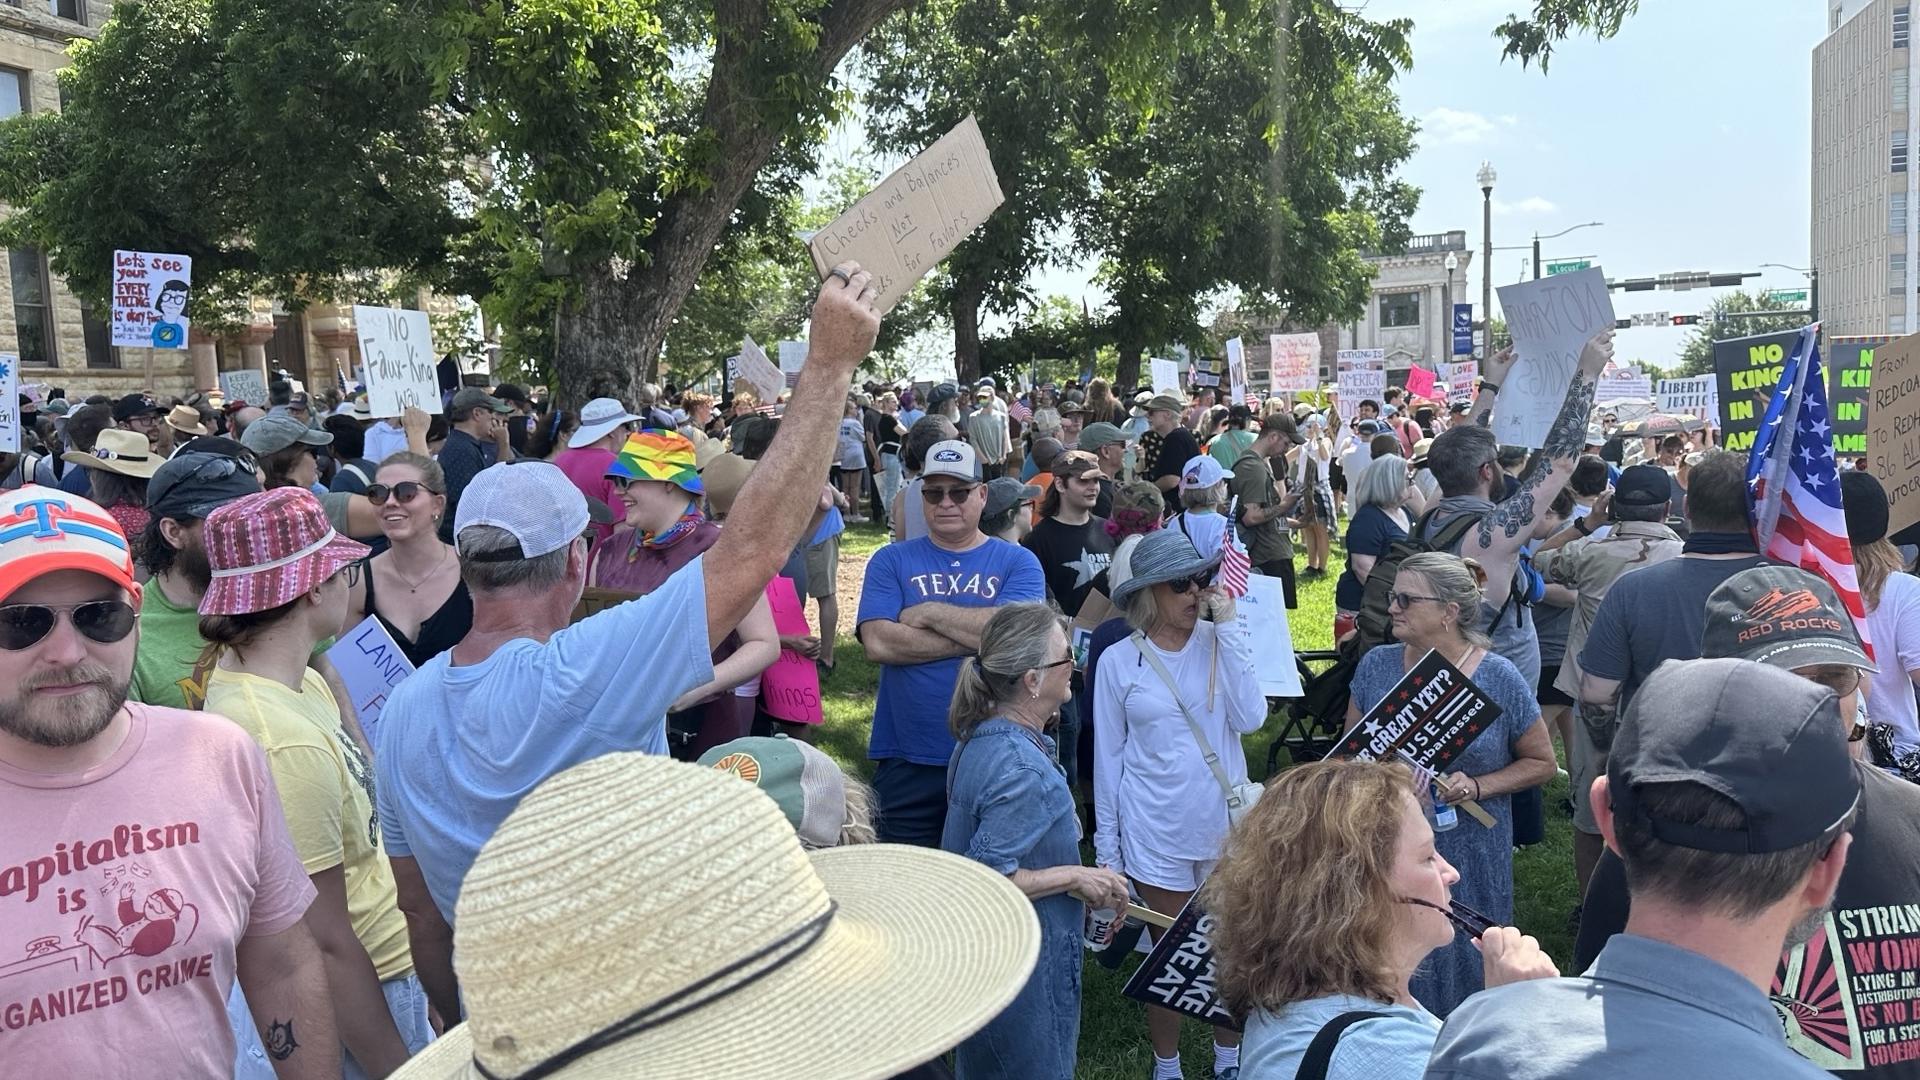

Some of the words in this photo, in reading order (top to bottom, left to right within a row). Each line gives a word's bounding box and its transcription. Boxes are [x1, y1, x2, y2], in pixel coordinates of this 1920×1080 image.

[824, 208, 877, 256] Checks
[885, 188, 904, 210] and
[905, 153, 960, 193] Balances
[891, 214, 913, 239] Not
[904, 252, 921, 272] for
[929, 210, 969, 252] Favors
[116, 268, 148, 282] your
[151, 257, 183, 272] see
[114, 309, 124, 322] is
[386, 312, 409, 341] NO
[1338, 350, 1372, 359] NOTHING
[1374, 350, 1383, 359] IS
[1749, 343, 1784, 366] NO
[1859, 349, 1875, 368] N
[1878, 352, 1910, 380] FROM
[363, 338, 436, 398] Faux-King
[1338, 373, 1384, 387] AMERICAN
[1452, 364, 1473, 375] LOVE
[1731, 365, 1786, 392] KING
[1841, 369, 1872, 388] KI
[1660, 380, 1709, 395] LIBERTY
[1666, 394, 1709, 409] JUSTIC
[1729, 400, 1754, 421] IN
[1837, 402, 1861, 421] IN
[1725, 430, 1757, 451] AM
[1873, 428, 1889, 448] TO
[935, 450, 960, 462] Ford
[1876, 450, 1897, 481] 86
[1903, 434, 1920, 466] AL
[1888, 475, 1920, 507] UTOCR
[15, 498, 70, 541] T
[1088, 552, 1112, 564] ONE
[910, 573, 1000, 600] TEXAS
[1737, 623, 1773, 643] RED
[1780, 617, 1842, 632] ROCKS
[1369, 704, 1418, 755] GREAT
[1411, 669, 1453, 712] YET?
[56, 887, 88, 915] is
[1089, 919, 1110, 946] hint
[1147, 913, 1217, 1004] GREAT
[0, 976, 129, 1032] GANIZED
[136, 953, 214, 996] CRIME
[1852, 970, 1896, 993] LYING
[1901, 970, 1916, 988] IN
[1858, 1004, 1878, 1028] IS
[1882, 1001, 1908, 1025] NO
[1863, 1028, 1887, 1046] FOR
[1888, 1026, 1897, 1043] A
[1900, 1022, 1920, 1041] SYS
